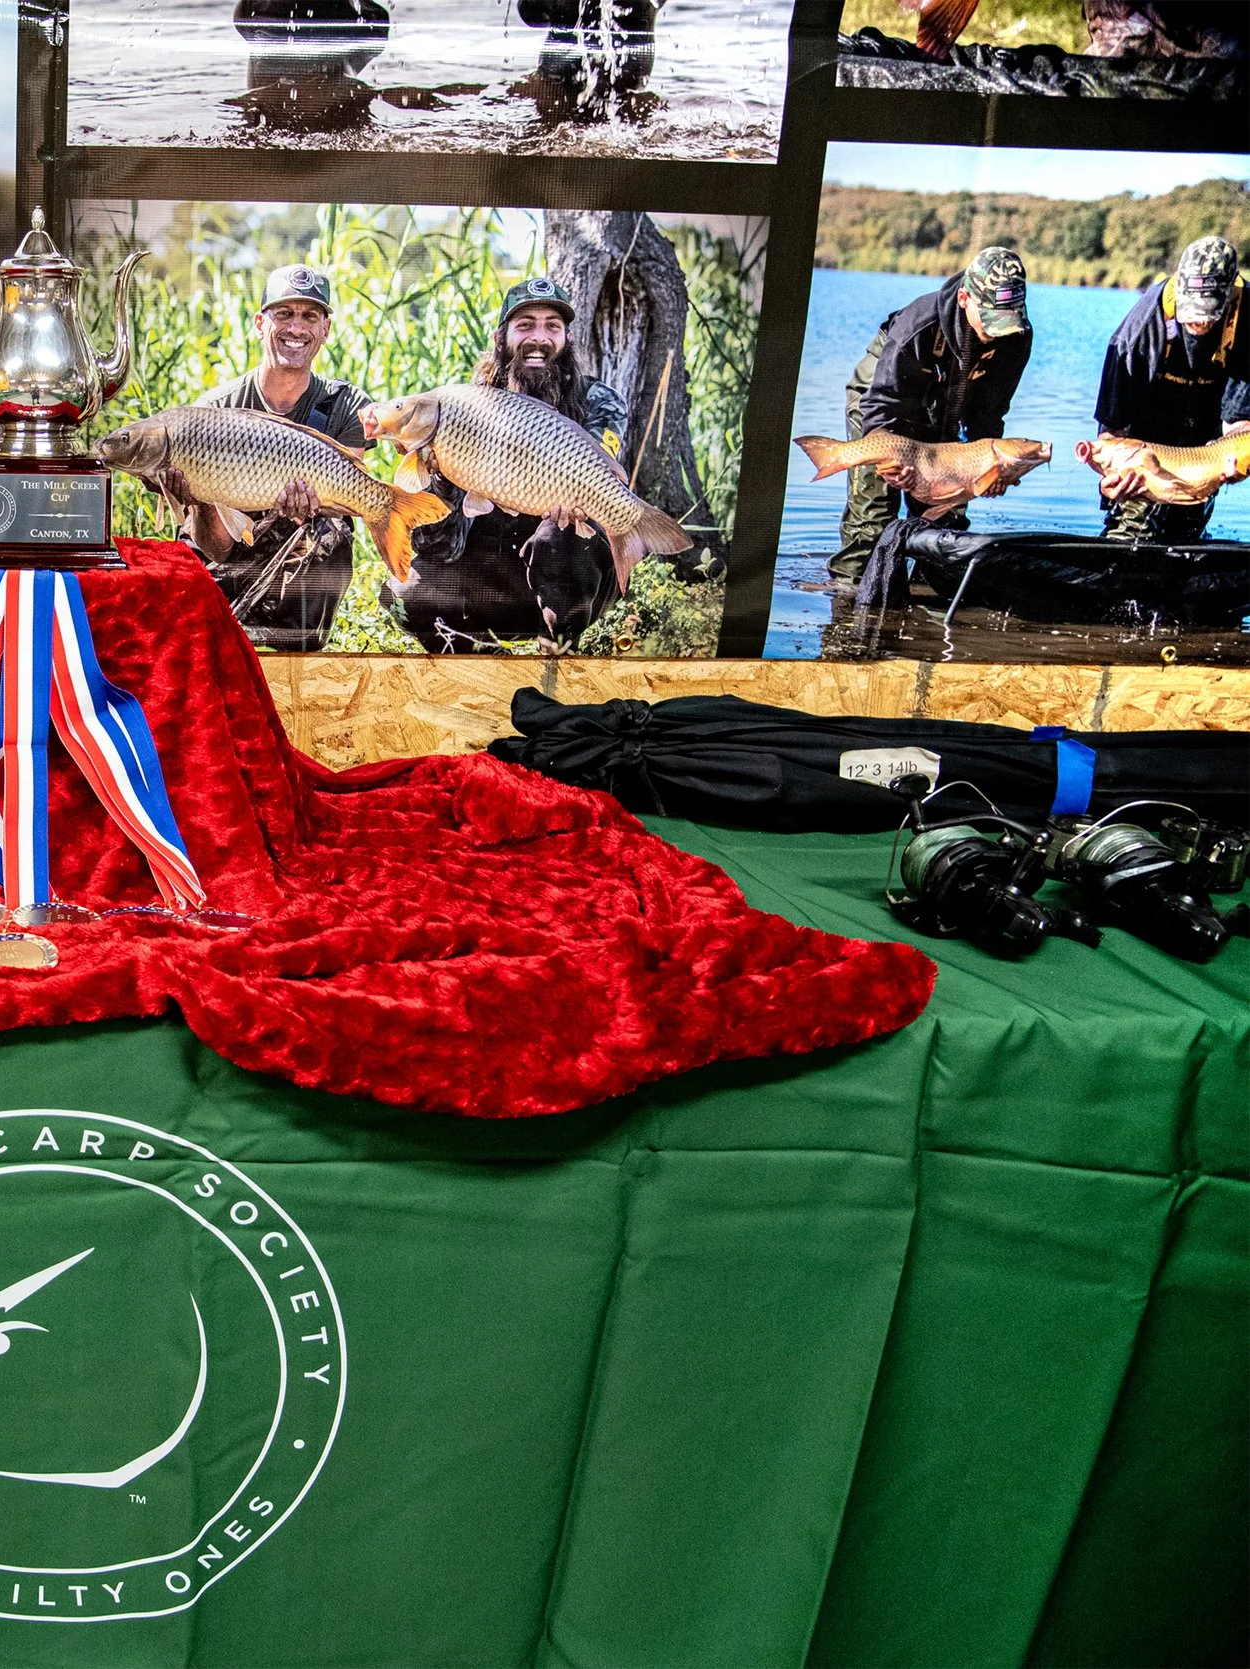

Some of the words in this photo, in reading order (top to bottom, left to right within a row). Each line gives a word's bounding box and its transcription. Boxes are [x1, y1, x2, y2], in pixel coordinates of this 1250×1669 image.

[20, 480, 40, 490] THE
[43, 480, 67, 490] MILL
[70, 481, 100, 490] CREEK
[50, 492, 70, 502] CUP
[29, 528, 72, 539] CANTON,
[74, 529, 90, 538] TX
[846, 764, 868, 778] 12'
[872, 763, 882, 776] 3
[888, 760, 918, 775] 14lb
[193, 1173, 330, 1385] SOCIETY
[129, 1494, 146, 1505] TM
[165, 1495, 274, 1595] ONES
